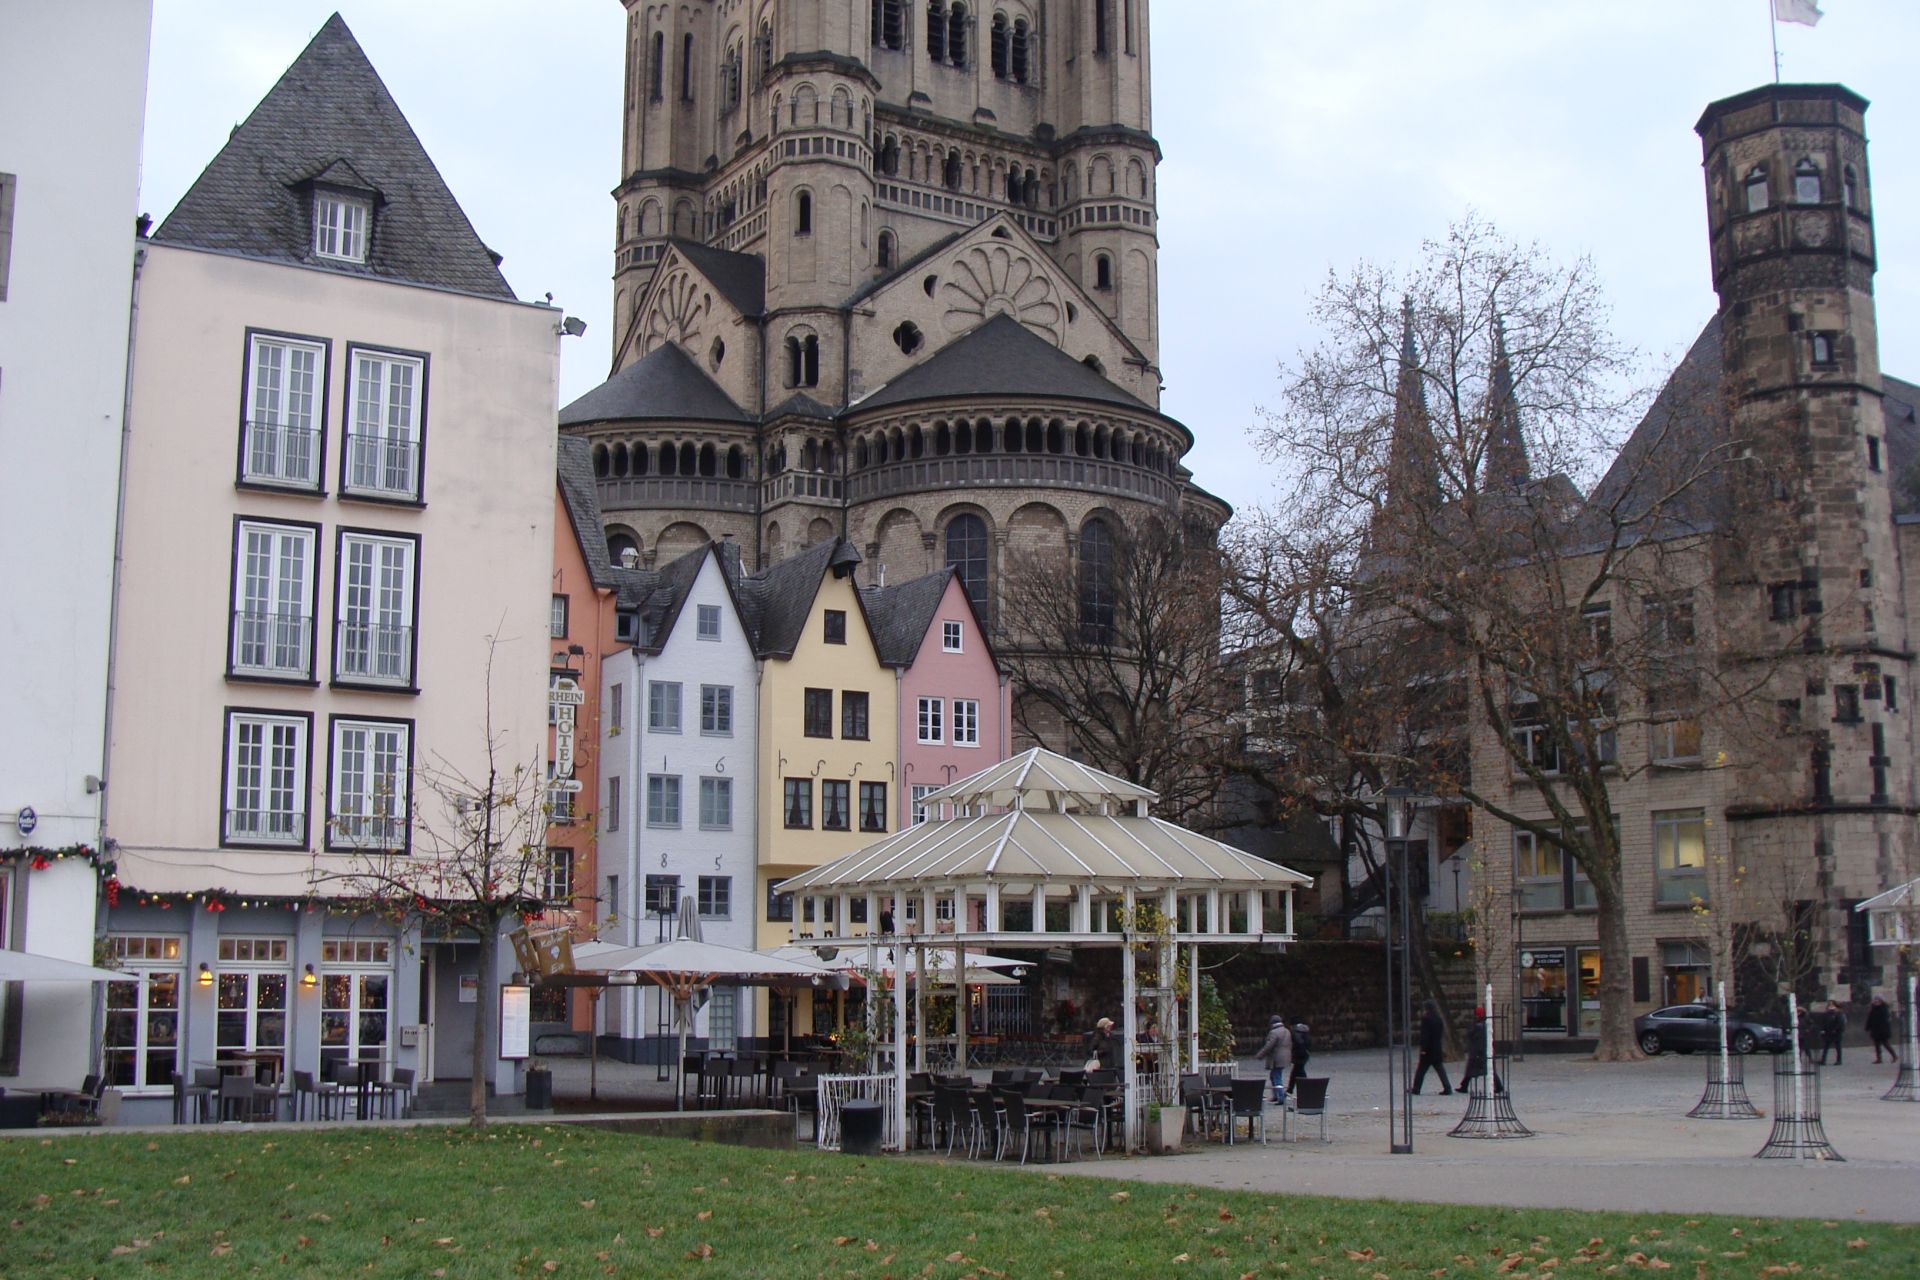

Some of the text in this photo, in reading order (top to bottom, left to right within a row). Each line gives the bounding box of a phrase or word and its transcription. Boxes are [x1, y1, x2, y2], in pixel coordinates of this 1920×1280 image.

[549, 691, 583, 703] RHEIN
[558, 707, 573, 775] HOTEL
[715, 756, 725, 773] 6
[660, 852, 668, 868] 8
